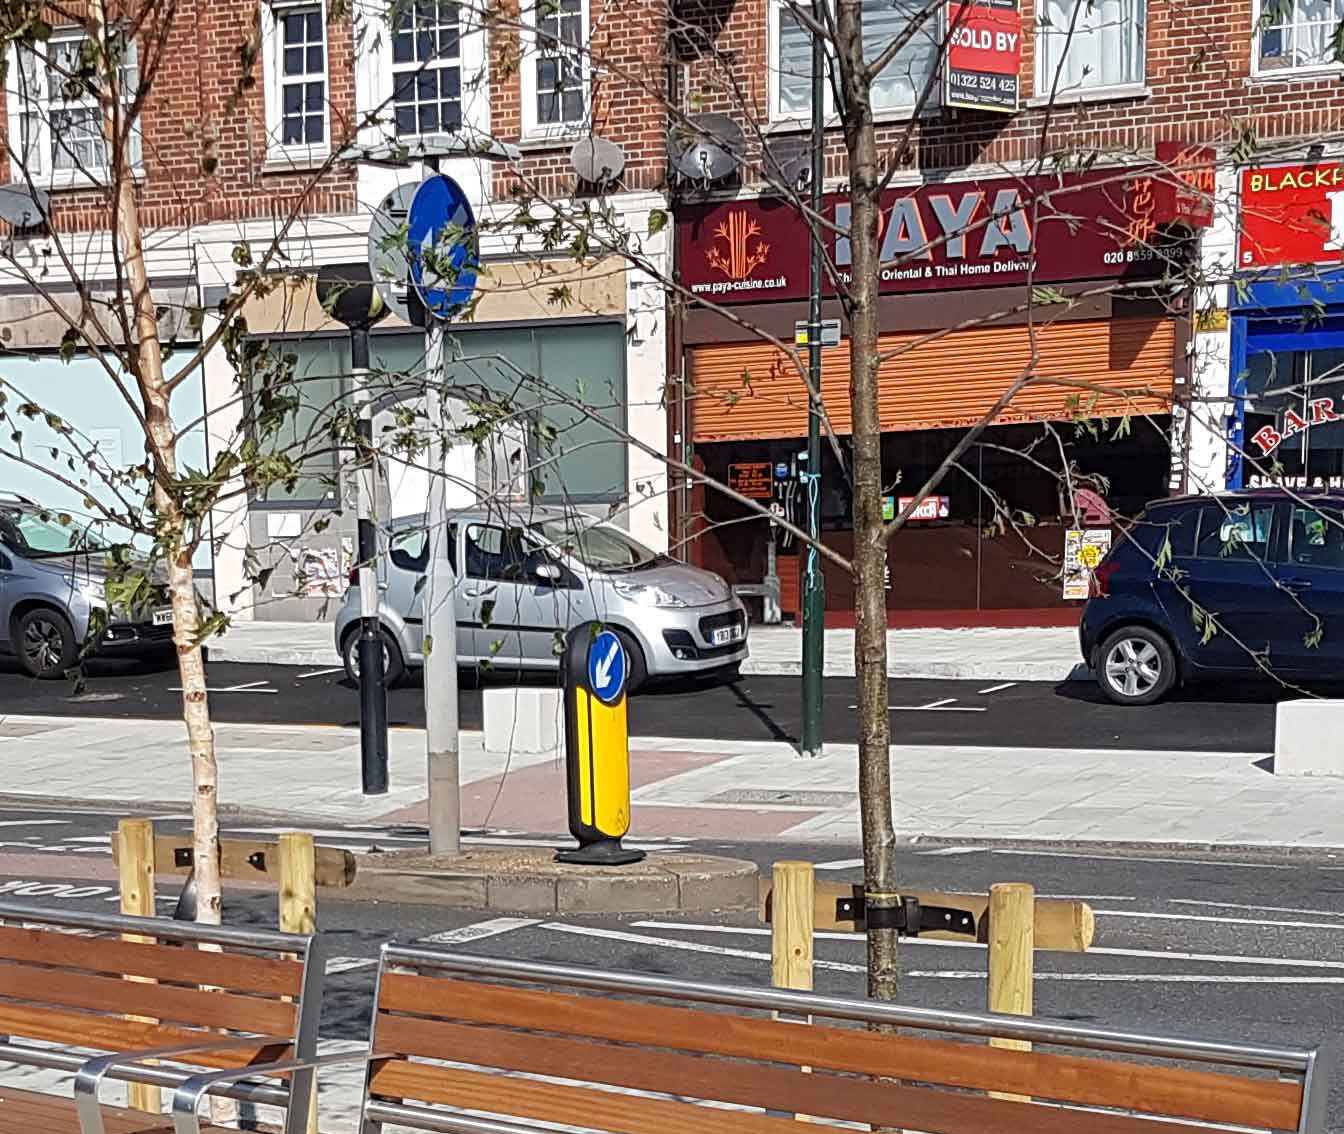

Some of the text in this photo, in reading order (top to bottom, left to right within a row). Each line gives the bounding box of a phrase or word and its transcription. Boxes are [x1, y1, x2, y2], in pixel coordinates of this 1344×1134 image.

[950, 27, 1017, 52] SOLD BY
[950, 73, 1015, 92] 01322 524 425
[1103, 251, 1124, 264] 020
[1243, 253, 1253, 263] 5
[882, 268, 923, 281] Oriental
[925, 267, 933, 277] &
[935, 264, 957, 277] Thai
[960, 262, 991, 275] Home
[691, 276, 788, 295] www.paya-cuisine.co.uk
